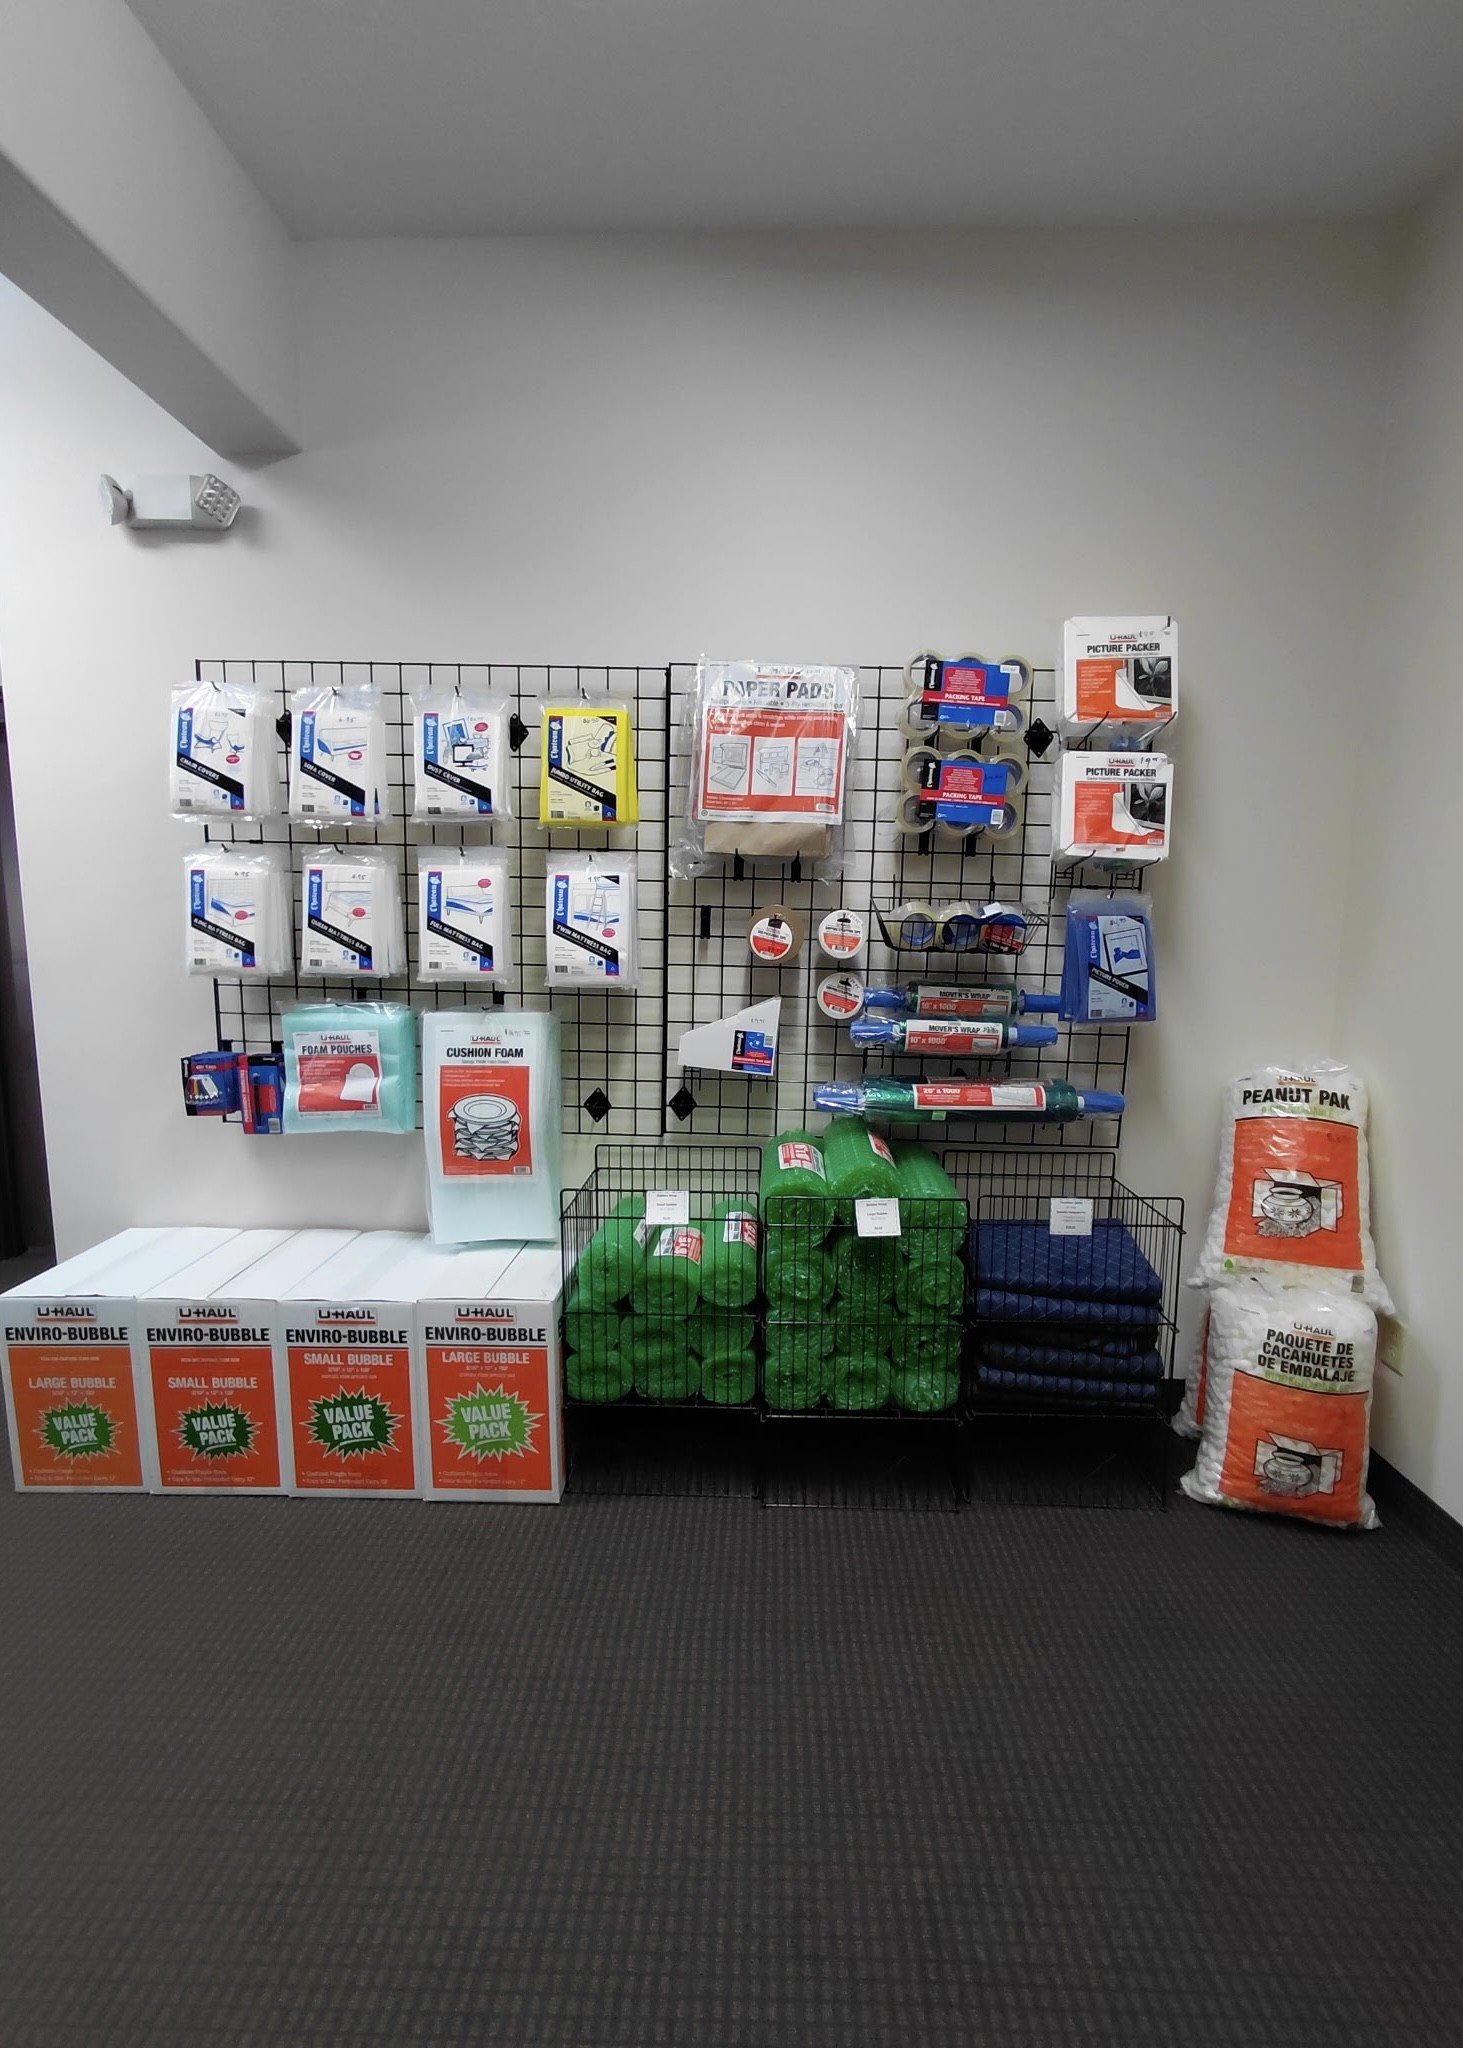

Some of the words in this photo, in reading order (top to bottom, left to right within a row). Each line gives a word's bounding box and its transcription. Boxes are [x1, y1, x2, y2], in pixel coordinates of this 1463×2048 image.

[1087, 644, 1123, 653] PICTURE
[1126, 642, 1160, 652] PACKER
[786, 681, 834, 699] PADS
[944, 693, 970, 701] PACKING
[179, 757, 198, 770] CHAIR
[198, 764, 220, 781] COVERS
[303, 761, 318, 773] SOFA
[317, 769, 337, 783] COVER
[427, 764, 442, 775] DUST
[1086, 767, 1121, 776] PICTURE
[1123, 768, 1157, 777] PACKER
[550, 767, 570, 780] JUMBO
[569, 776, 592, 791] UTILITY
[591, 787, 604, 798] BAG
[968, 793, 983, 801] TAPE
[193, 918, 207, 928] KING
[207, 923, 235, 941] MATTRESS
[234, 936, 246, 947] BAG
[310, 919, 328, 931] QUEEN
[327, 926, 355, 945] MATTRESS
[354, 941, 367, 952] BAG
[429, 920, 443, 930] FULL
[442, 925, 471, 943] MATTRESS
[470, 939, 484, 950] BAG
[556, 924, 572, 936] TWIN
[571, 930, 600, 949] MATTRESS
[599, 945, 612, 956] BAG
[1091, 967, 1113, 981] PICTURE
[1112, 975, 1130, 990] POUCH
[929, 1025, 958, 1033] MOVER'S
[961, 1026, 981, 1034] WRAP
[302, 1045, 328, 1054] FOAM
[331, 1044, 372, 1054] POUCHES
[446, 1047, 492, 1058] CUSHION
[495, 1048, 524, 1058] FOAM
[1242, 1088, 1312, 1105] PEANUT
[1319, 1090, 1350, 1110] PAK
[37, 1306, 95, 1316] U-HAUL
[179, 1308, 237, 1318] U-HAUL
[318, 1309, 375, 1319] U-HAUL
[457, 1307, 514, 1318] U-HAUL
[5, 1326, 128, 1341] ENVIRO-BUBBLE
[147, 1327, 270, 1342] ENVIRO-BUBBLE
[286, 1328, 408, 1344] ENVIRO-BUBBLE
[425, 1326, 546, 1342] ENVIRO-BUBBLE
[1293, 1322, 1335, 1337] U-HAUL
[1266, 1328, 1332, 1354] PAQUETE
[1336, 1342, 1354, 1356] DE
[304, 1353, 344, 1366] SMALL
[347, 1353, 394, 1366] BUBBLE
[441, 1351, 480, 1363] LARGE
[483, 1352, 530, 1364] BUBBLE
[1262, 1341, 1354, 1369] CACAHUETES
[1257, 1354, 1275, 1370] DE
[1280, 1361, 1355, 1383] EMBALAJE
[29, 1376, 67, 1389] LARGE
[70, 1376, 116, 1389] BUBBLE
[168, 1376, 209, 1389] SMALL
[211, 1376, 258, 1389] BUBBLE
[323, 1404, 375, 1424] VALUE
[460, 1403, 512, 1423] VALUE
[52, 1412, 98, 1431] VALUE
[191, 1413, 236, 1431] VALUE
[61, 1428, 98, 1445] PACK
[199, 1428, 237, 1446] PACK
[331, 1421, 374, 1441] PACK
[468, 1421, 511, 1440] PACK
